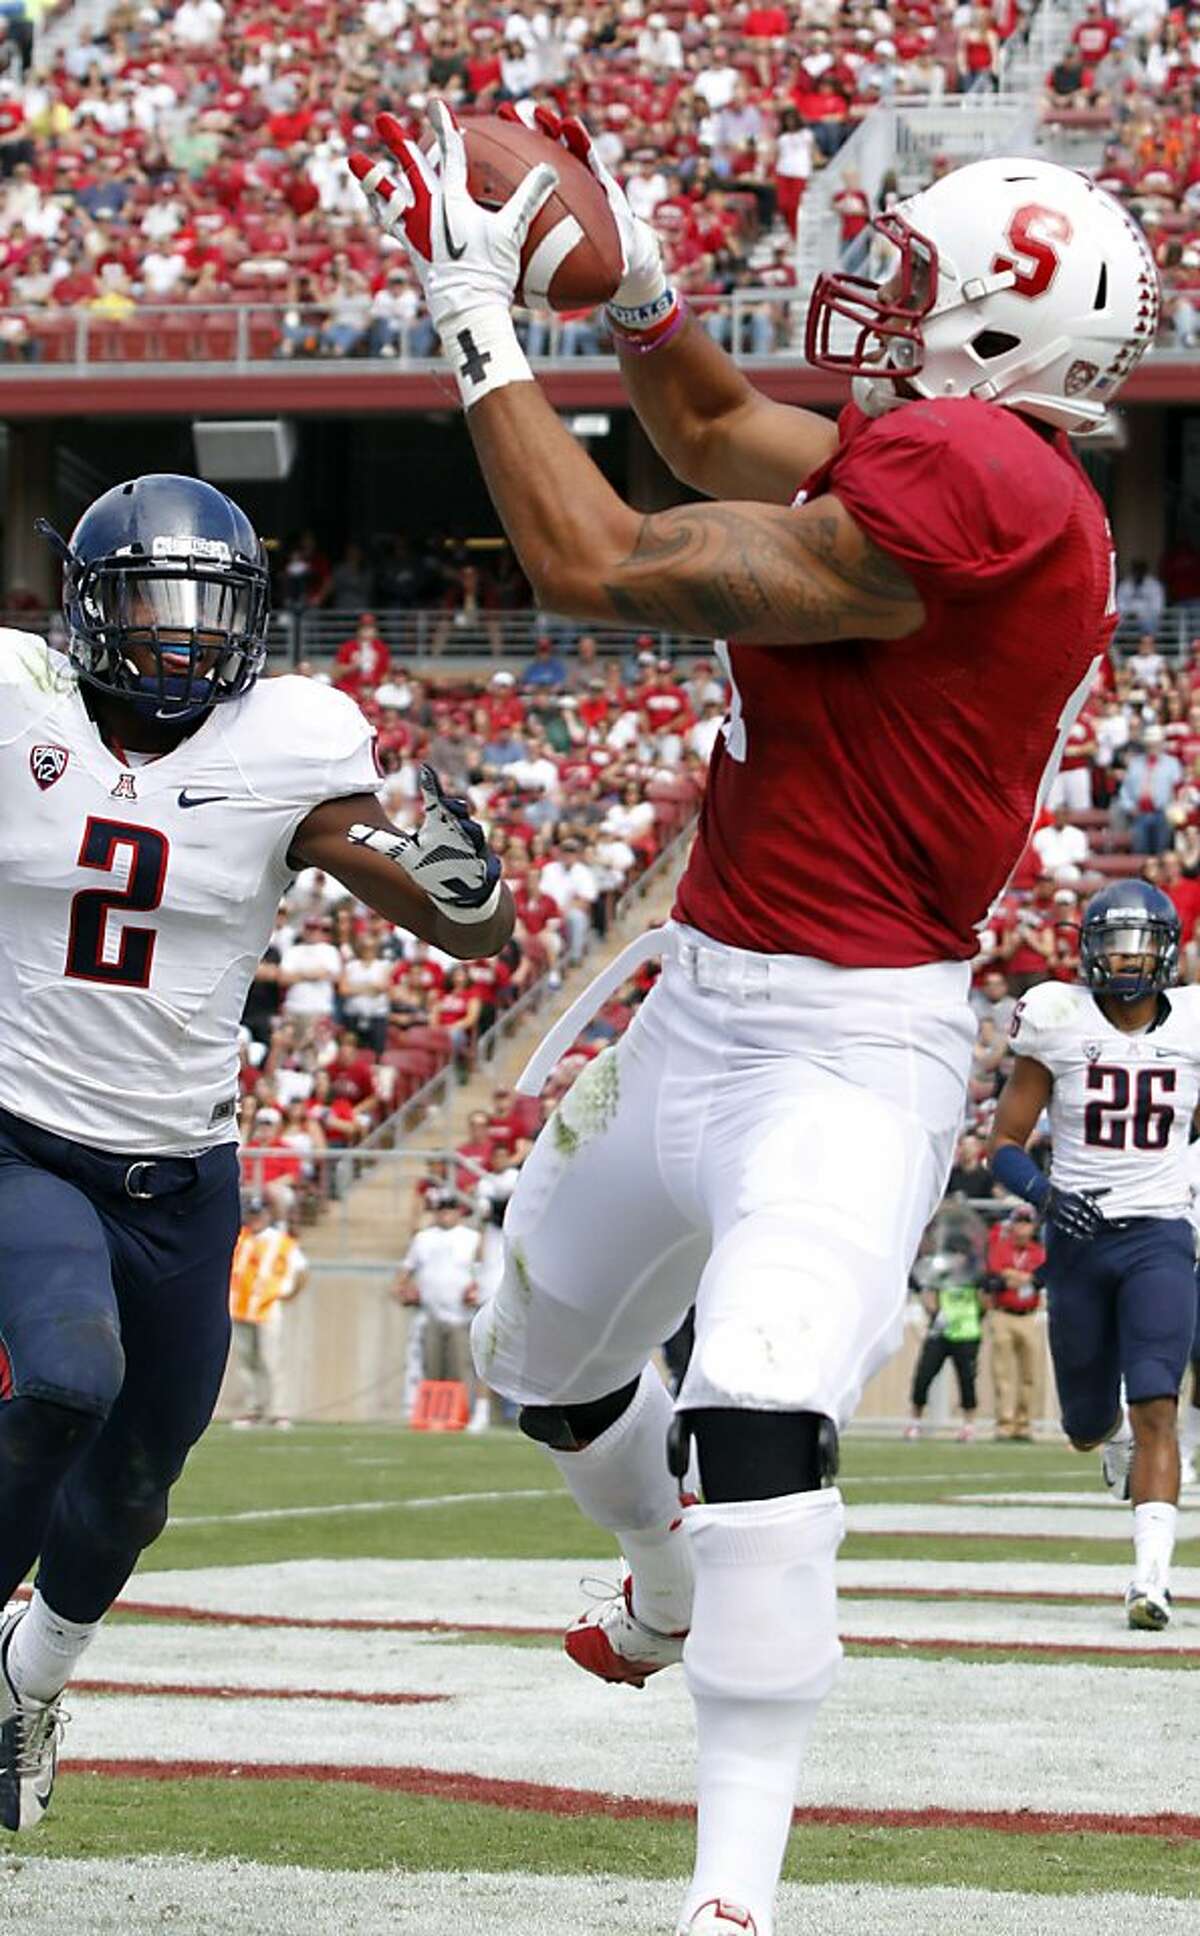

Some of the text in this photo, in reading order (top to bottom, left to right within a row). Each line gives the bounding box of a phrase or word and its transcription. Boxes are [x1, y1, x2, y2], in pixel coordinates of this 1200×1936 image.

[991, 202, 1072, 303] S
[38, 764, 55, 780] 12
[111, 773, 137, 799] A
[64, 815, 170, 988] 2
[1084, 1064, 1177, 1152] 26
